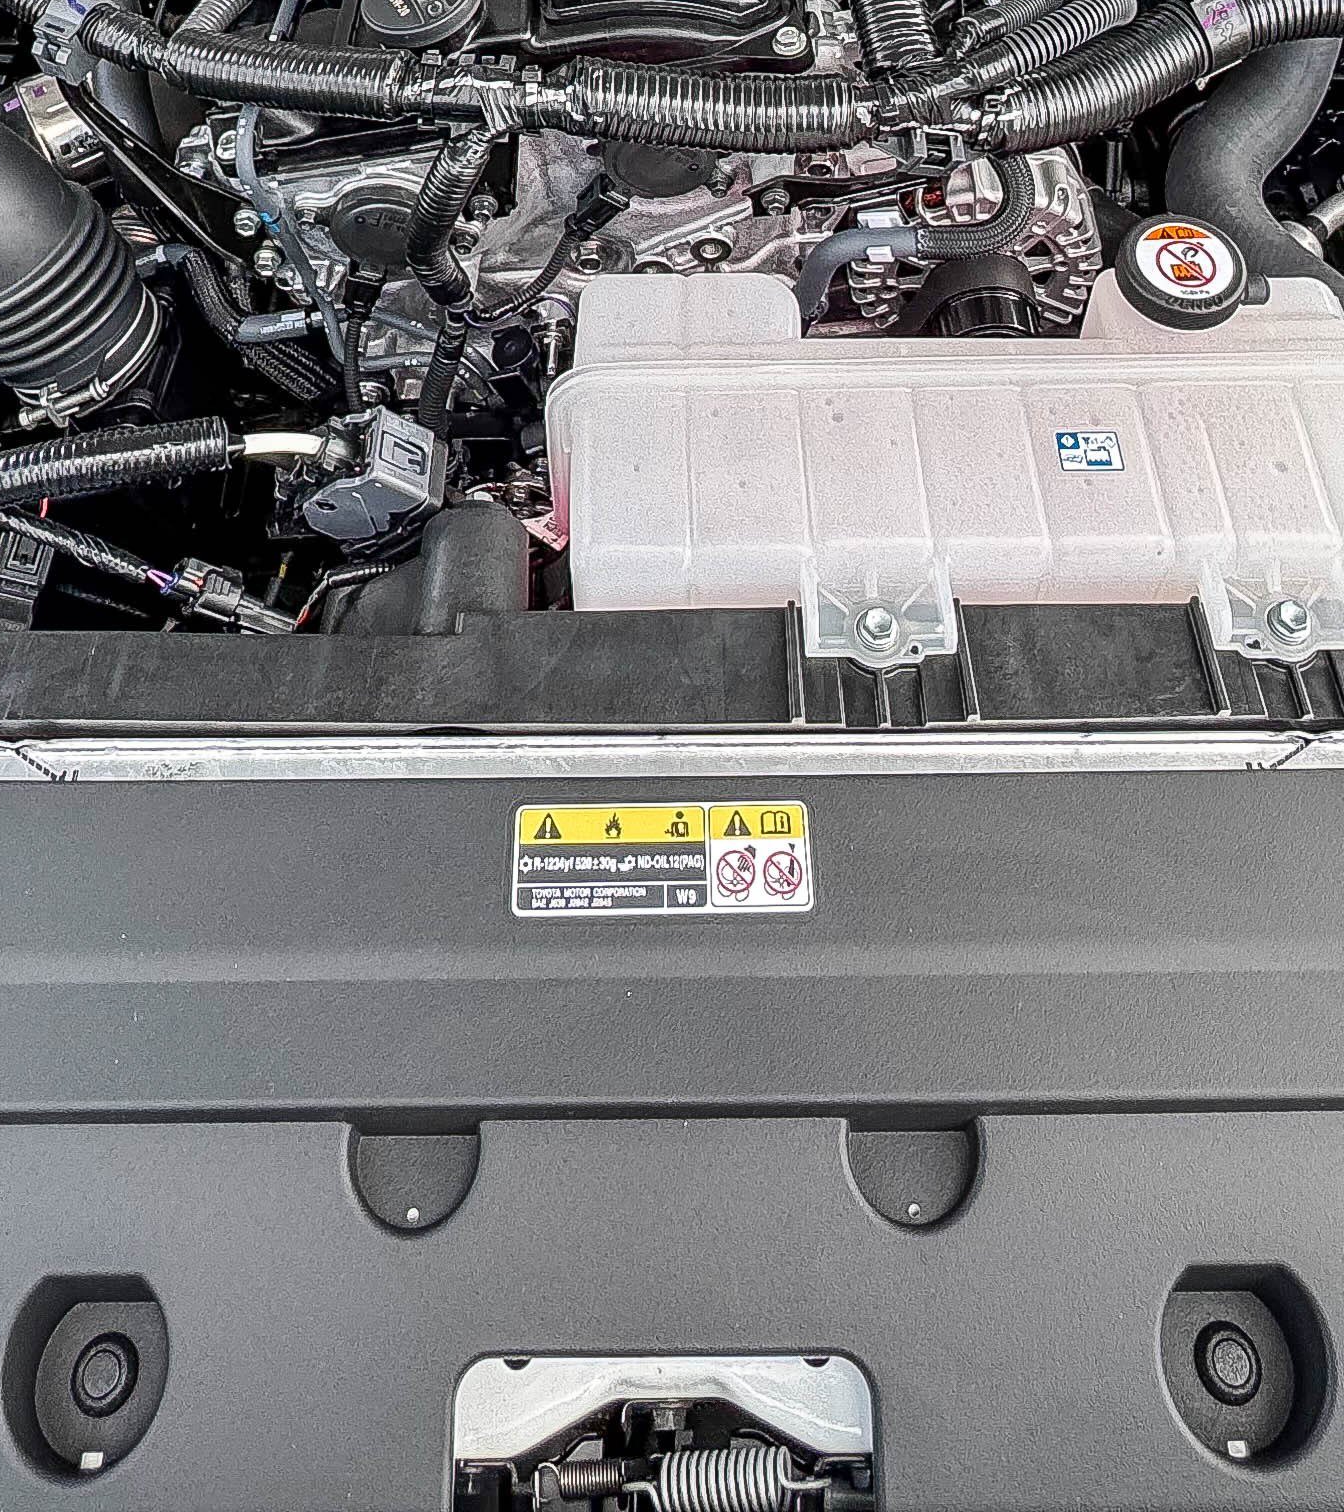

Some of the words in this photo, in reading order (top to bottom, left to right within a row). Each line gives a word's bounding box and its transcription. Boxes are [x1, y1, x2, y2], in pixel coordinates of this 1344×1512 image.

[531, 888, 561, 898] TOYOTA
[563, 887, 591, 898] MOTOR
[593, 886, 647, 898] CORPORATION
[675, 888, 697, 905] W9
